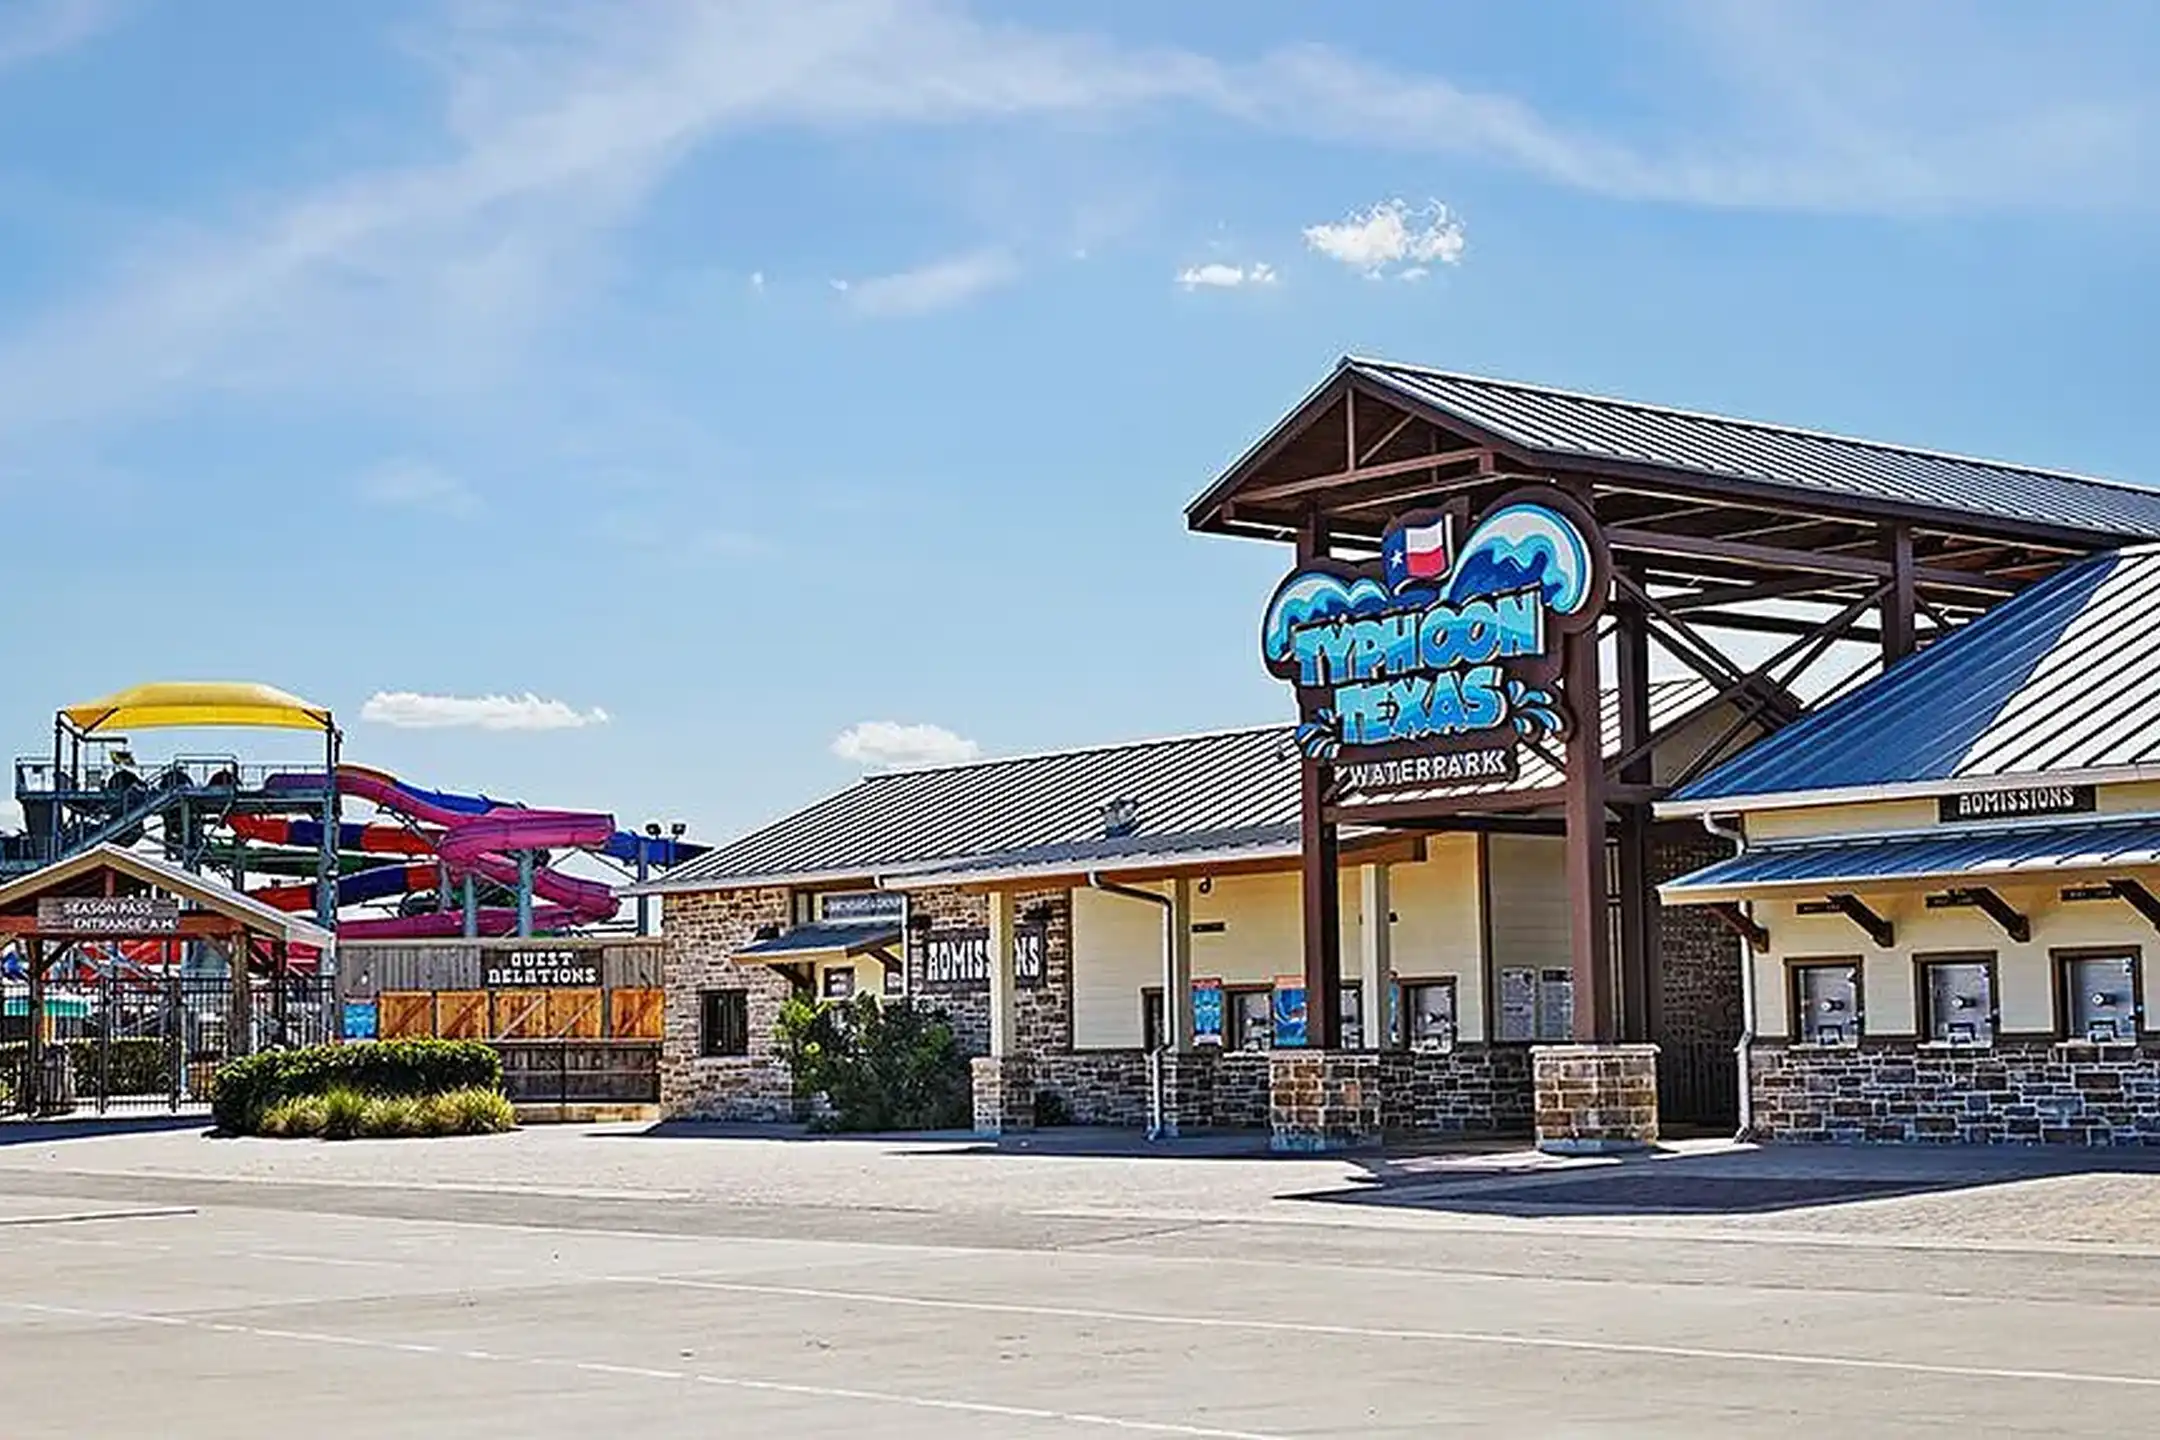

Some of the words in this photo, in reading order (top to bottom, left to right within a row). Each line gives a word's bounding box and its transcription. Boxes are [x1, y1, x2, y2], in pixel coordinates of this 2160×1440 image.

[1292, 590, 1543, 686] TYPHOON
[1335, 667, 1506, 745] TEXAS
[1350, 750, 1506, 788] WATERPARK
[1959, 786, 2074, 815] ADMISSIONS
[64, 903, 116, 915] SEASON
[119, 902, 153, 915] PASS
